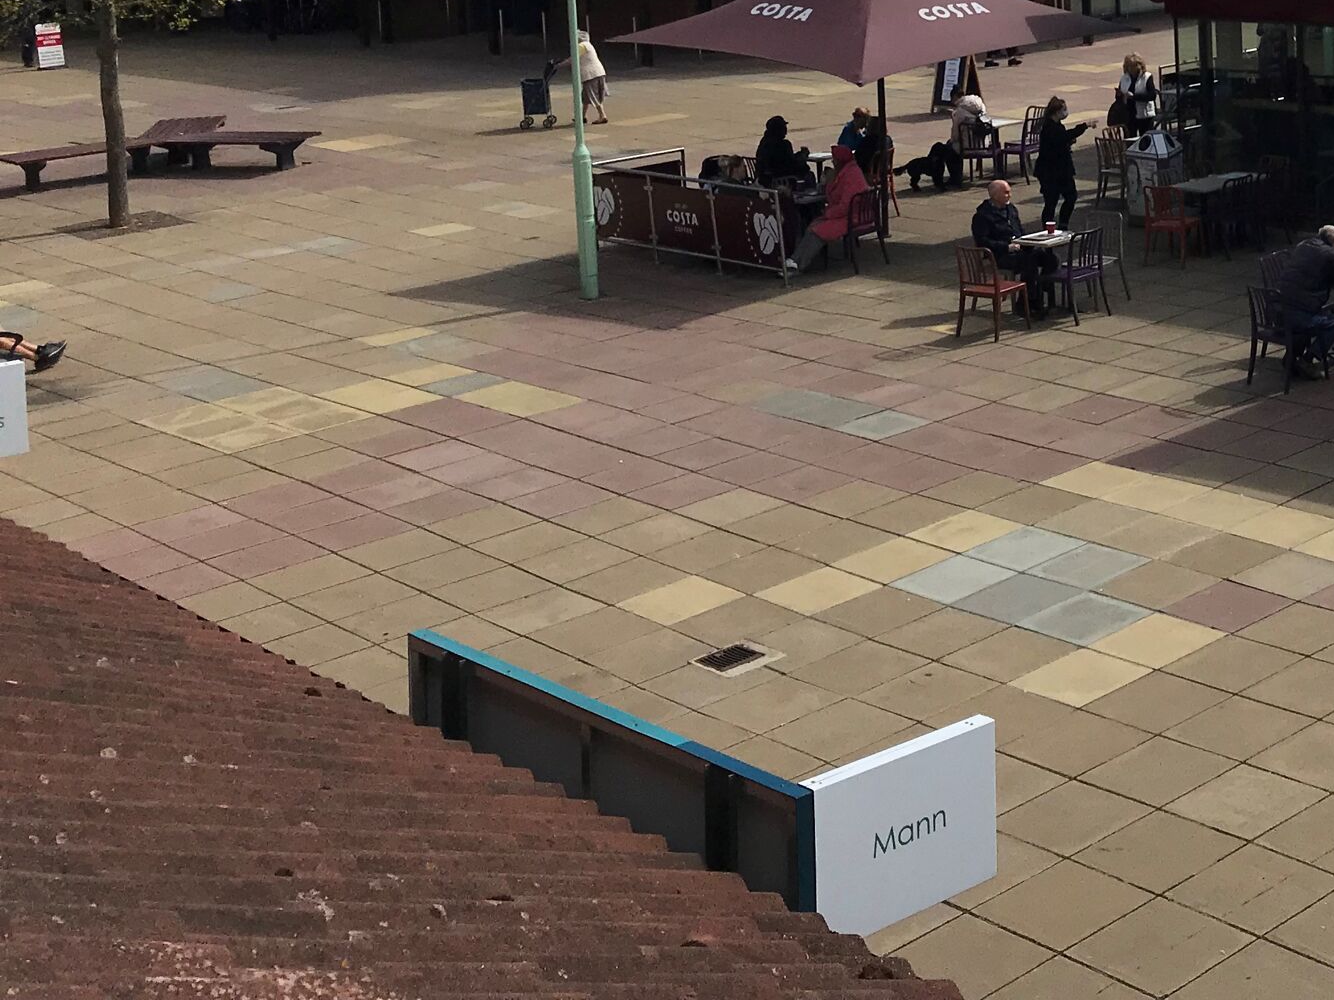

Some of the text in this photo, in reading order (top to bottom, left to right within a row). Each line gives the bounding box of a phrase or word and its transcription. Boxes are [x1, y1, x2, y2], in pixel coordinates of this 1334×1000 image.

[750, 2, 814, 22] COSTA
[918, 1, 991, 21] COSTA
[666, 209, 699, 226] COSTA
[873, 809, 947, 859] Mann
